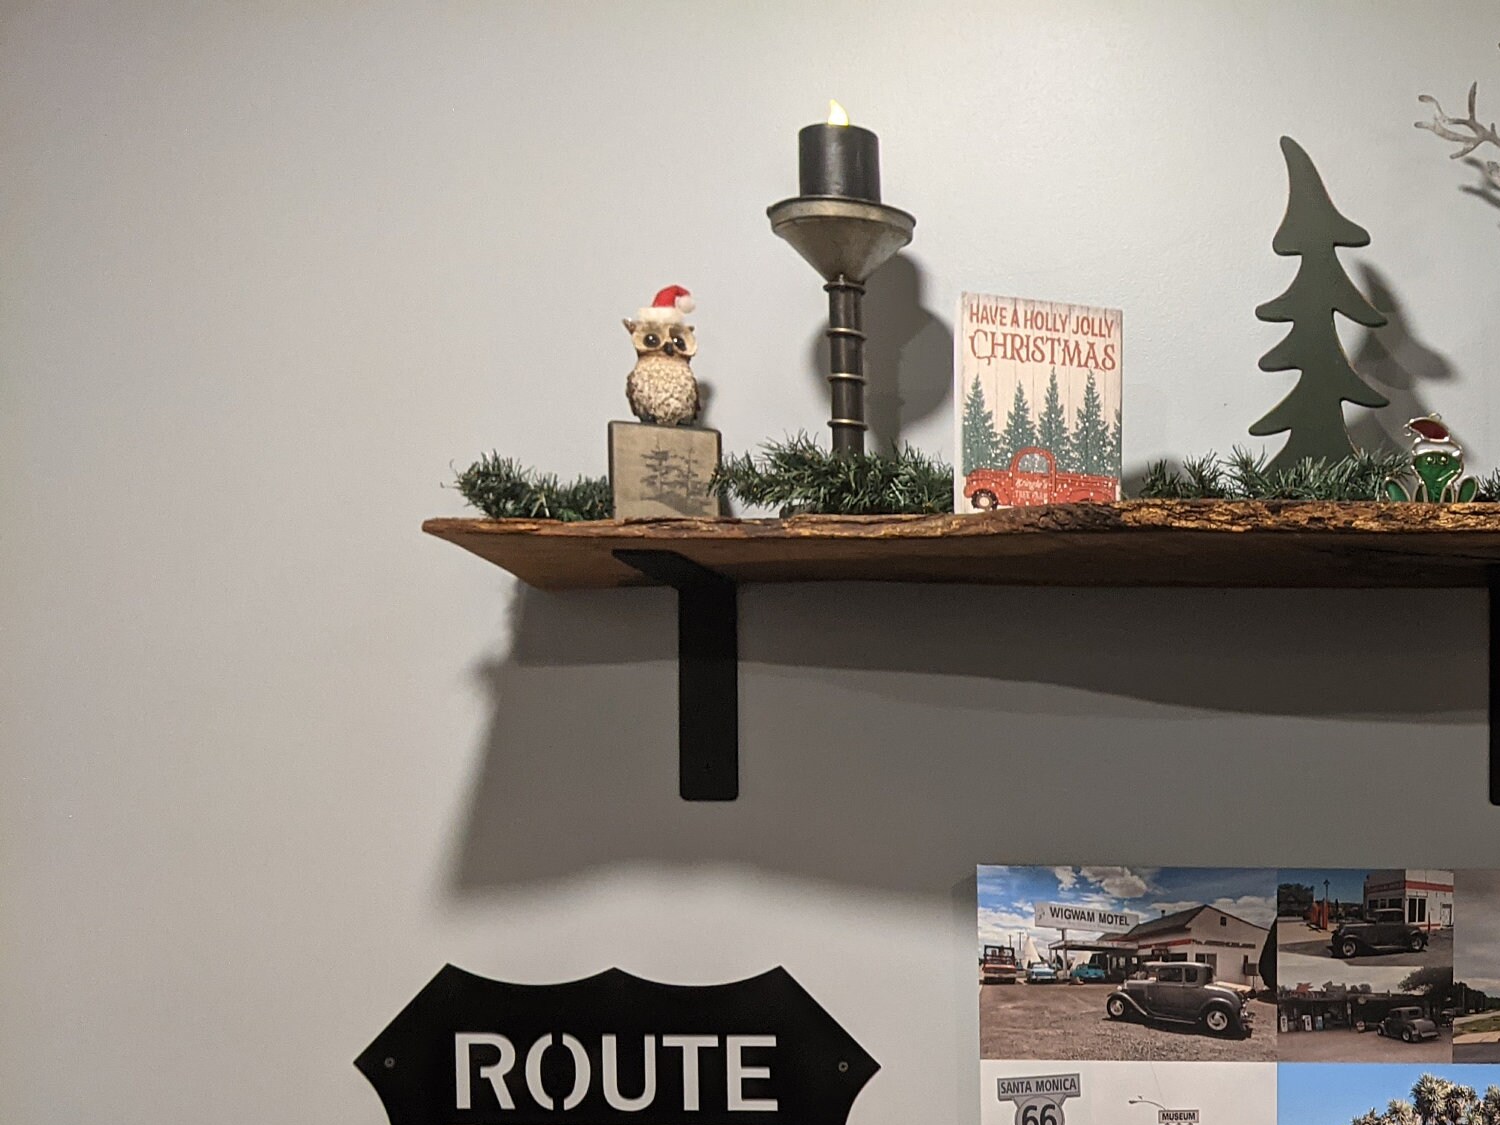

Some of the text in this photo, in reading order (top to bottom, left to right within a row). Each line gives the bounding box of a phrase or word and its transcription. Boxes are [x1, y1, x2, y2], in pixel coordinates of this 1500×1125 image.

[969, 303, 1114, 338] HAVE A HOLLY JOLLY
[969, 328, 1117, 371] CHRISTMAS
[1049, 906, 1095, 923] WIGWAM
[1098, 912, 1130, 926] MOTEL
[454, 1031, 779, 1112] ROUTE
[1000, 1078, 1077, 1094] SANTA MONICA
[1161, 1112, 1196, 1121] MUSEUM
